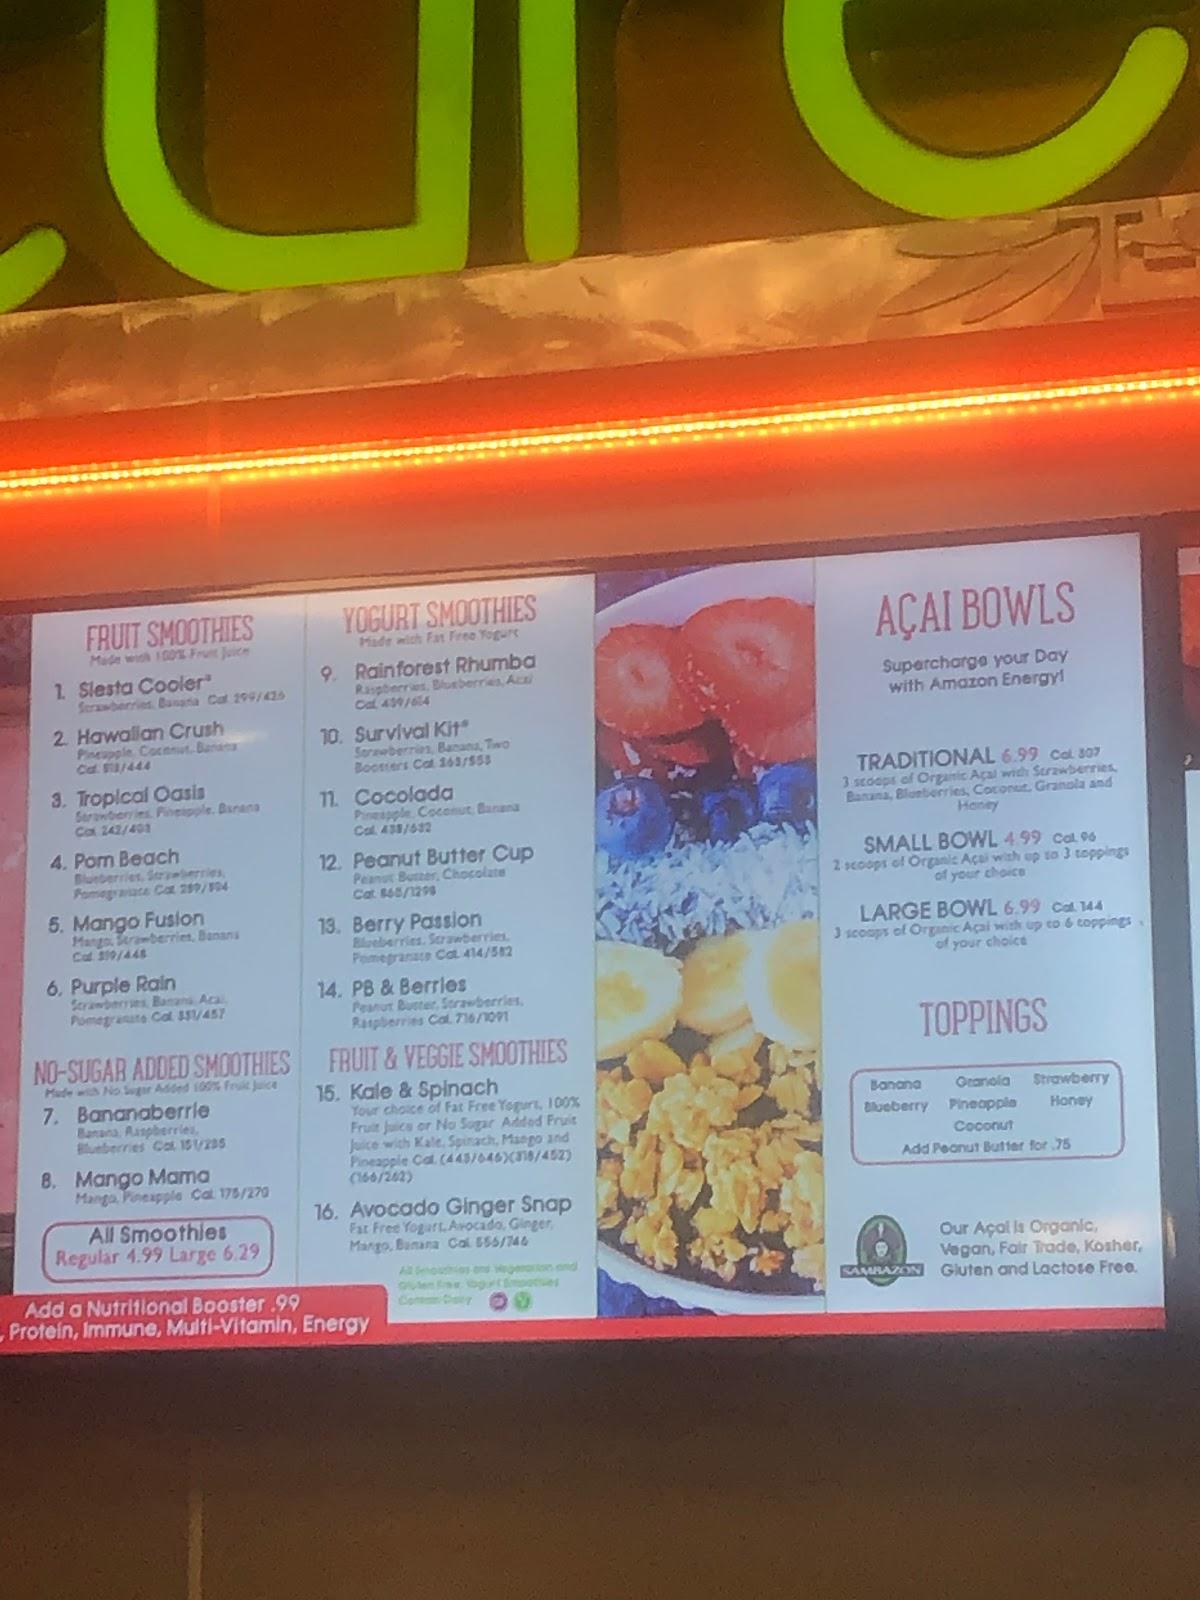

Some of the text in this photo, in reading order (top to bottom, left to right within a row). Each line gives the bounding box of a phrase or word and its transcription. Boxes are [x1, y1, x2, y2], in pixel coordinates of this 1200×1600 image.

[342, 594, 537, 634] YOGURT SMOOTHIES
[875, 581, 1076, 640] AÇAI BOWLS
[86, 615, 254, 650] FRUIT SMOOTHIES
[359, 628, 518, 648] Made with Fat Free Yogurt
[355, 658, 450, 680] Rainforest
[456, 654, 536, 673] Rhumba
[882, 649, 1069, 674] Supercharge your Day
[54, 683, 65, 700] 1.
[78, 680, 133, 698] Siesta
[889, 669, 1064, 693] with Amazon Energy!
[53, 721, 224, 746] 2. Hawaiian Crush
[320, 728, 342, 744] 10.
[355, 722, 429, 743] Survival
[858, 747, 996, 771] TRADITIONAL
[1001, 747, 1039, 763] 6.99
[51, 784, 205, 809] 3. Tropical Oasis
[320, 785, 453, 807] 11. Cocolada
[477, 802, 520, 814] Banana
[864, 834, 932, 854] SMALL
[938, 830, 997, 850] BOWL
[1004, 830, 1041, 846] 4.99
[1080, 831, 1096, 842] 96
[50, 849, 179, 870] 4. Pom Beach
[319, 844, 534, 871] 12. Peanut Butter Cup
[834, 859, 840, 870] 2
[845, 858, 887, 871] scoops
[892, 856, 904, 868] of
[908, 854, 958, 869] Organic
[993, 851, 1020, 862] with
[1024, 851, 1040, 863] up
[1045, 849, 1058, 860] to
[1063, 847, 1070, 859] 3
[1075, 845, 1129, 860] toppings
[935, 866, 1026, 882] of your choice
[860, 901, 931, 922] LARGE
[937, 899, 997, 918] BOWL
[1004, 899, 1040, 915] 6.99
[1080, 900, 1103, 912] 144
[48, 911, 204, 934] 5. Mango Fusion
[318, 911, 482, 935] 13. Berry Passion
[198, 930, 239, 941] Banana
[46, 975, 176, 997] 6. Purple Rain
[318, 977, 466, 998] 14. PB & Berries
[920, 998, 1048, 1037] TOPPINGS
[329, 1039, 568, 1073] FRUIT & VEGGIE SMOOTHIES
[34, 1051, 291, 1085] NO-SUGAR ADDED SMOOTHIES
[1033, 1072, 1110, 1086] Strawberry
[316, 1078, 498, 1102] 15. Kale & Spinach
[870, 1079, 921, 1091] Banana
[956, 1075, 1010, 1088] Granola
[864, 1100, 928, 1113] Blueberry
[949, 1097, 1017, 1110] Pineapple
[1050, 1095, 1092, 1108] Honey
[43, 1102, 210, 1125] 7. Bananaberrie
[954, 1120, 1013, 1132] Coconut
[902, 1139, 1071, 1156] Add Peanut Butter for .75
[41, 1169, 210, 1190] 8. Mango Mama
[314, 1196, 572, 1221] 16. Avocado Ginger Snap
[88, 1222, 226, 1244] All Smoothies
[940, 1221, 968, 1235] Our
[1014, 1220, 1024, 1234] is
[1030, 1218, 1098, 1235] Organic,
[56, 1244, 260, 1269] Regular 4.99 Large 6.29
[940, 1238, 1142, 1257] Vegan, Fair Trade, Kosher,
[941, 1260, 1138, 1277] Gluten and Lactose Free.
[25, 1295, 300, 1319] Add a Nutritional Booster .99
[9, 1315, 370, 1341] Protein, Immune, Multi-Vitamin, Energy
